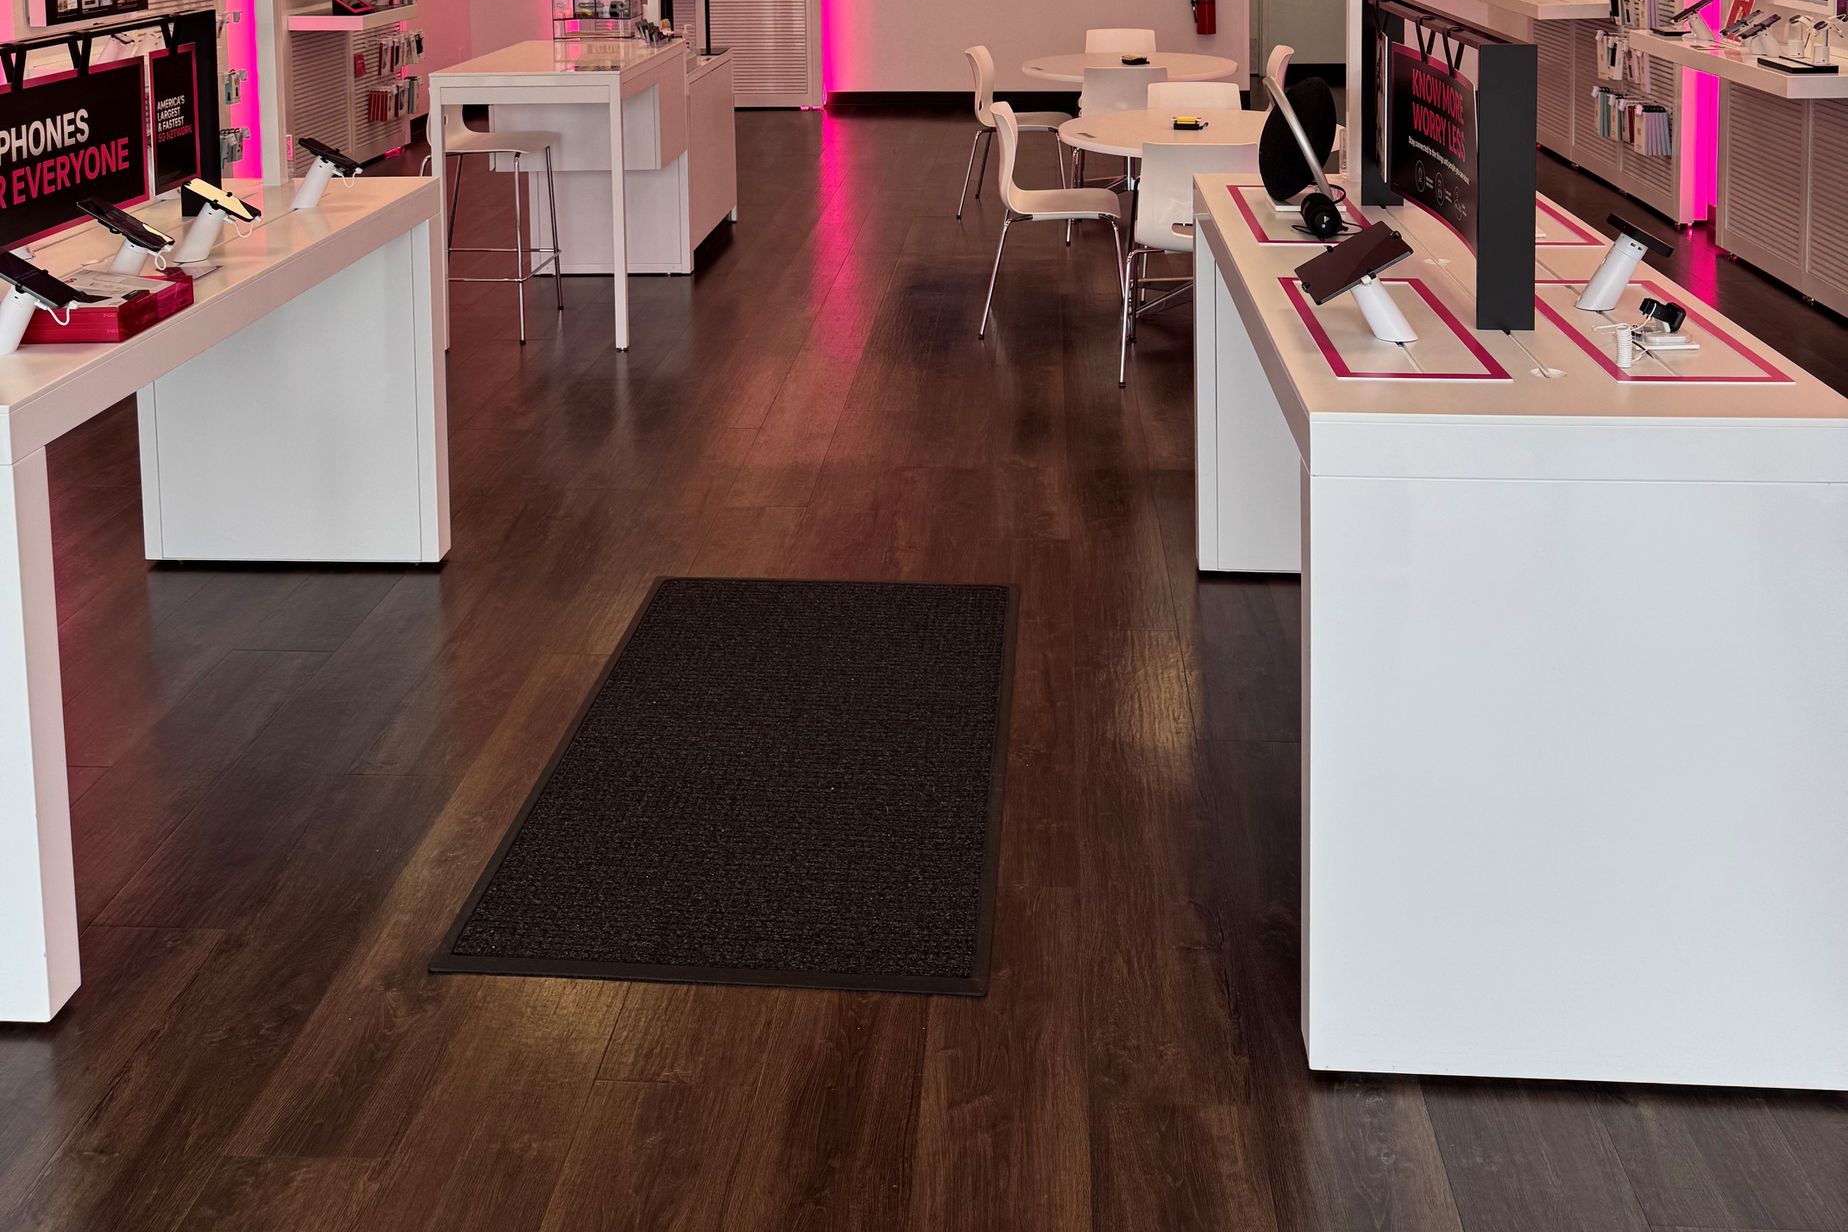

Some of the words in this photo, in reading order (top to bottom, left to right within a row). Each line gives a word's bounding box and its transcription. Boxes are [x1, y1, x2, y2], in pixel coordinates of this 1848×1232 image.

[157, 95, 185, 111] AMERICA'S
[157, 106, 181, 122] LARGEST
[1412, 68, 1442, 108] KNOW
[1442, 84, 1464, 125] MORE
[0, 108, 90, 166] PHONES
[157, 123, 162, 132] &
[162, 116, 184, 131] FASTEST
[166, 125, 192, 141] NETWORK
[1412, 102, 1446, 146] WORRY
[1448, 121, 1466, 163] LESS
[12, 137, 130, 205] EVERYONE
